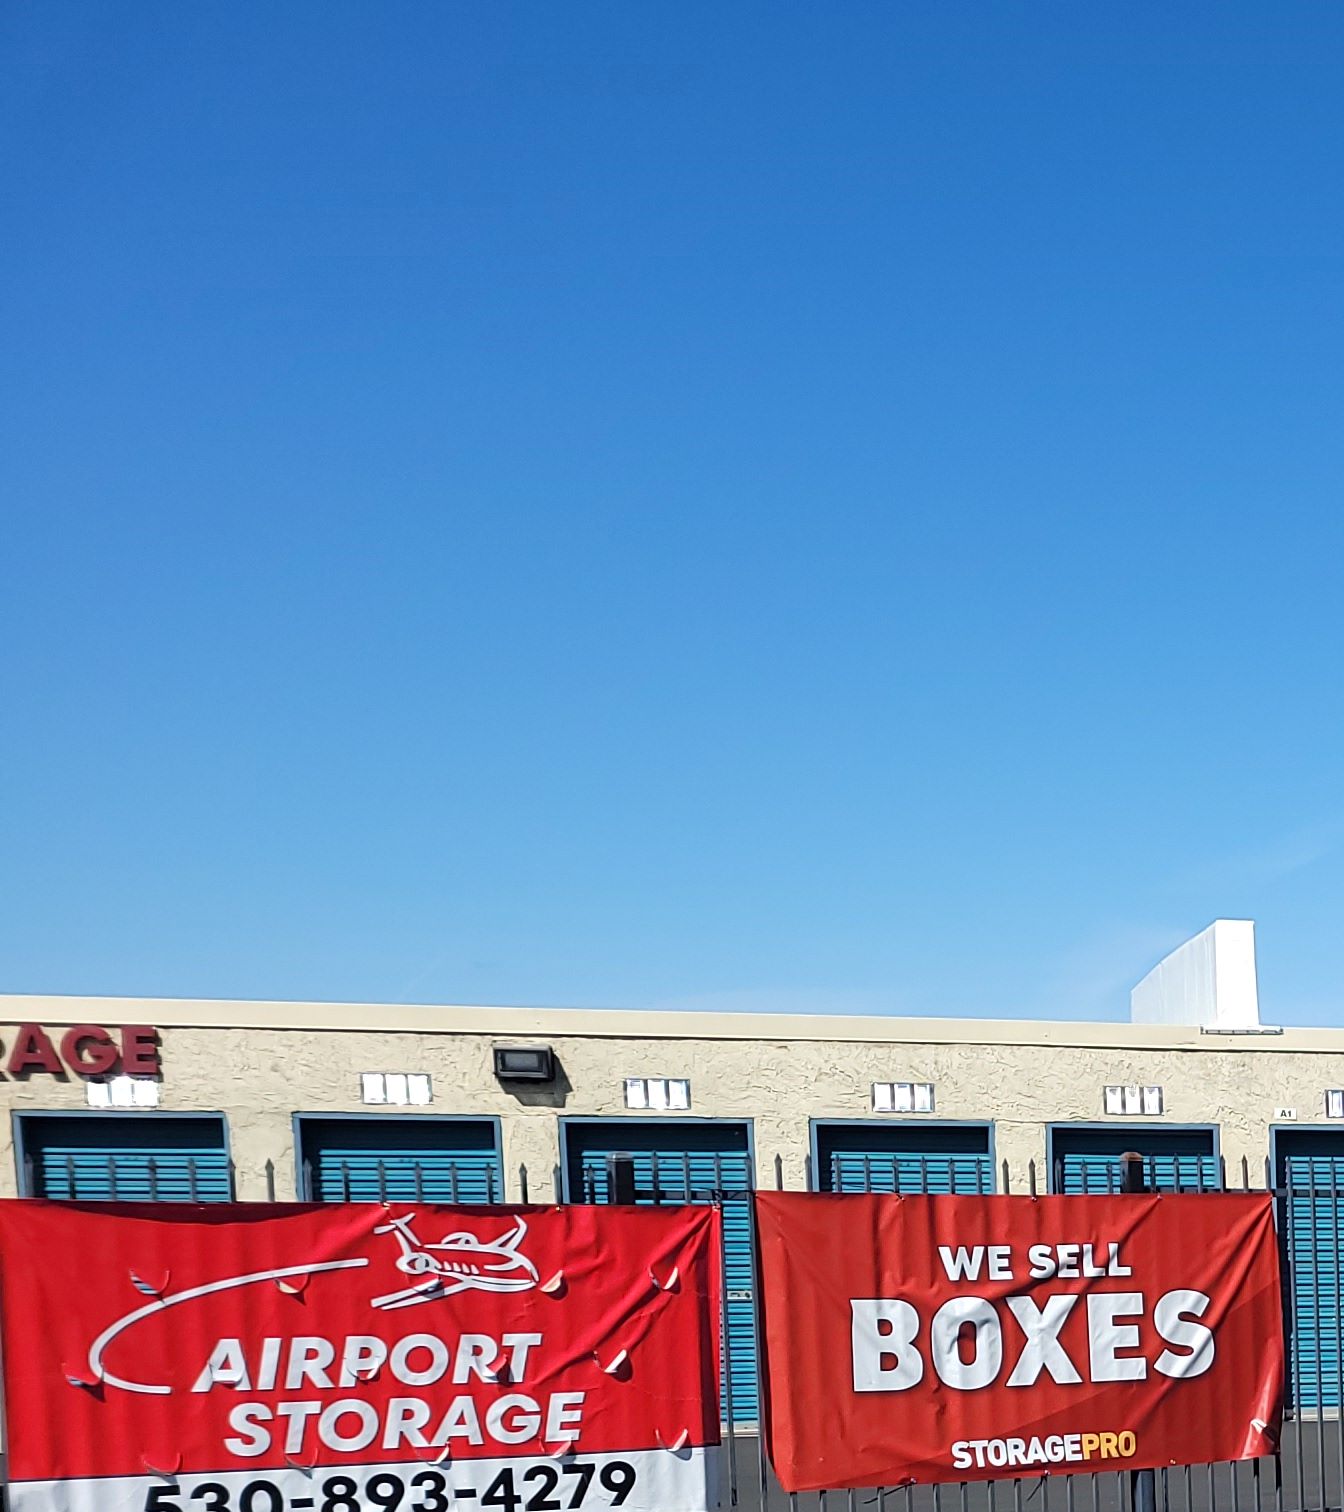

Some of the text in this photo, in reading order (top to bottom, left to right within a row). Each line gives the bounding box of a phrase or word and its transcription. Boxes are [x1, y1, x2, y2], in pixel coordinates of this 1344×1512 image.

[1280, 1109, 1292, 1118] A1
[938, 1243, 1132, 1281] WE SELL
[190, 1332, 542, 1393] AIRPORT
[849, 1289, 1216, 1393] BOXES
[223, 1391, 585, 1456] STORAGE
[951, 1430, 1136, 1469] STORAGEPRO
